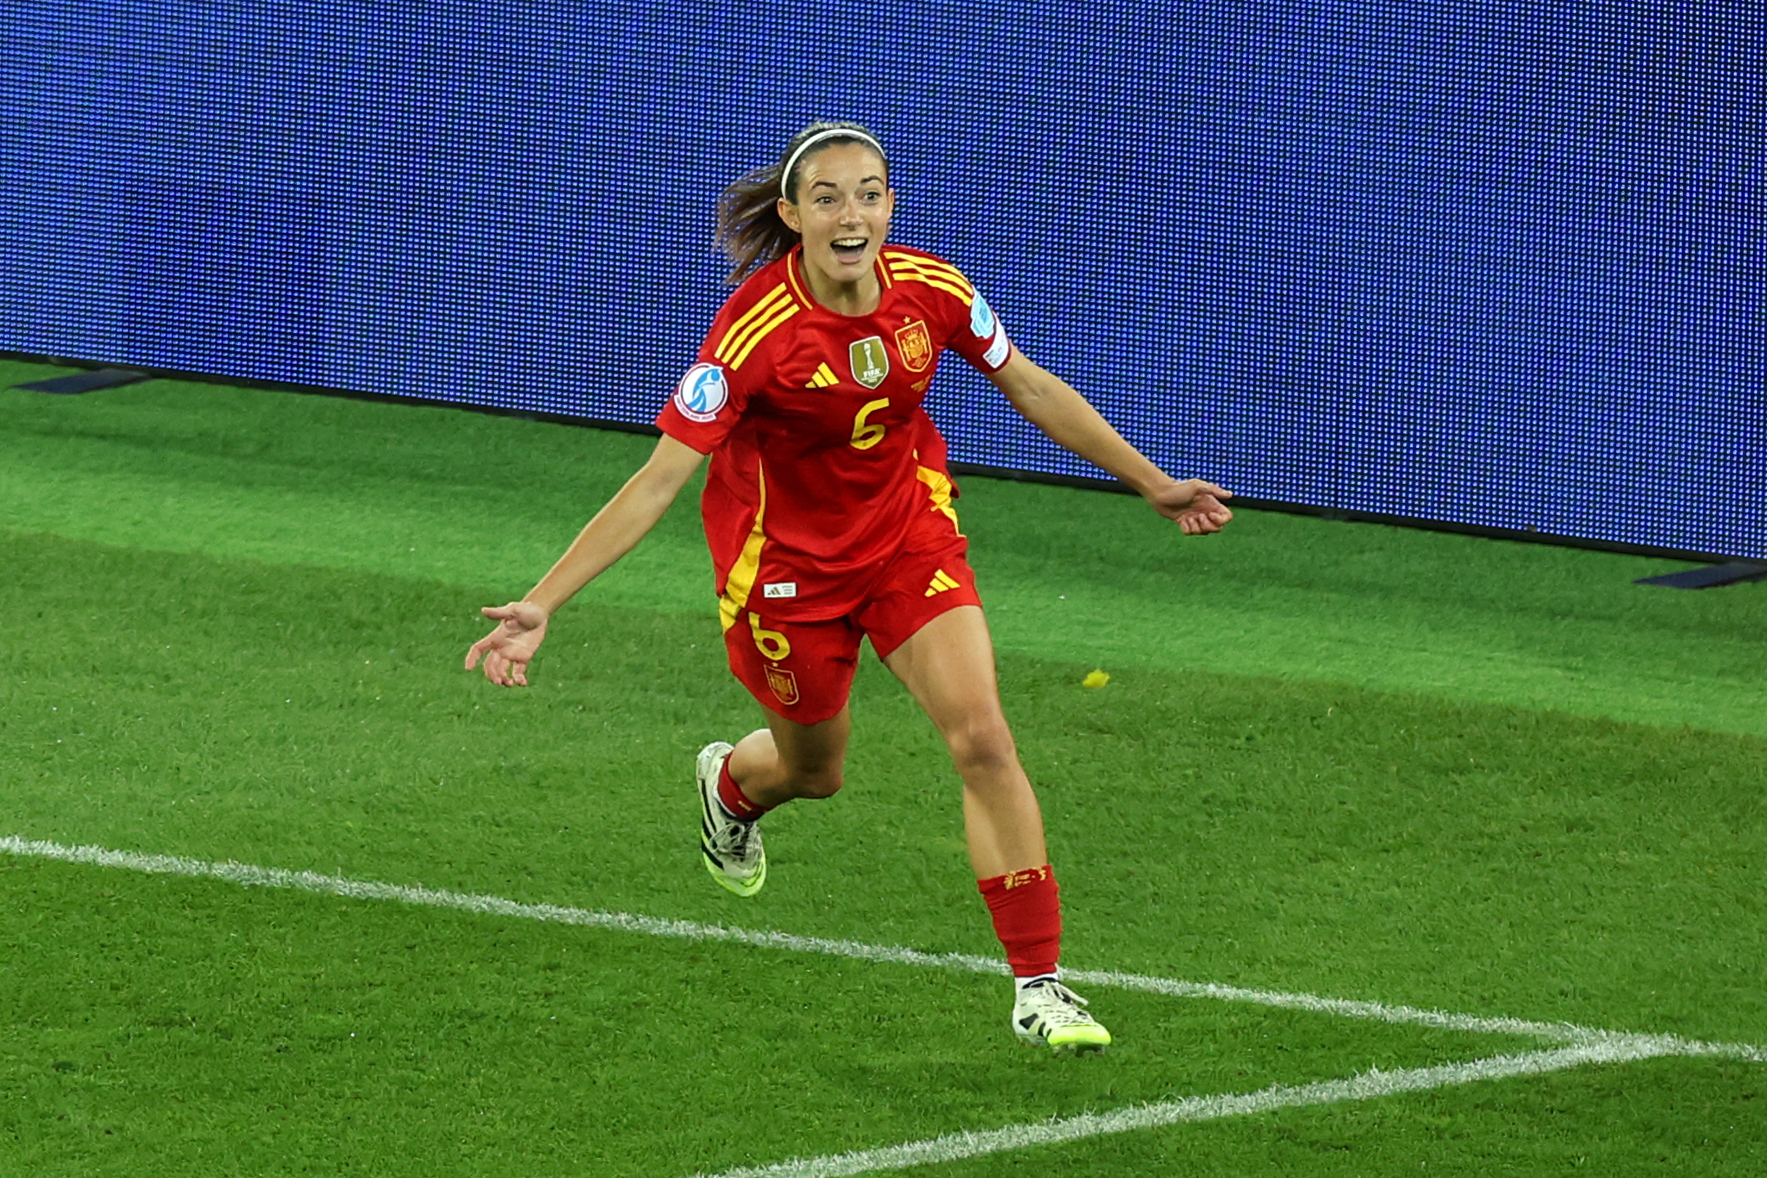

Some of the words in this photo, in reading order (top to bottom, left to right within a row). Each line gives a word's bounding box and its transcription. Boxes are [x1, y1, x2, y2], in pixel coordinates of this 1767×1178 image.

[863, 368, 880, 378] FIFA
[849, 397, 890, 450] 6
[748, 611, 791, 661] 6
